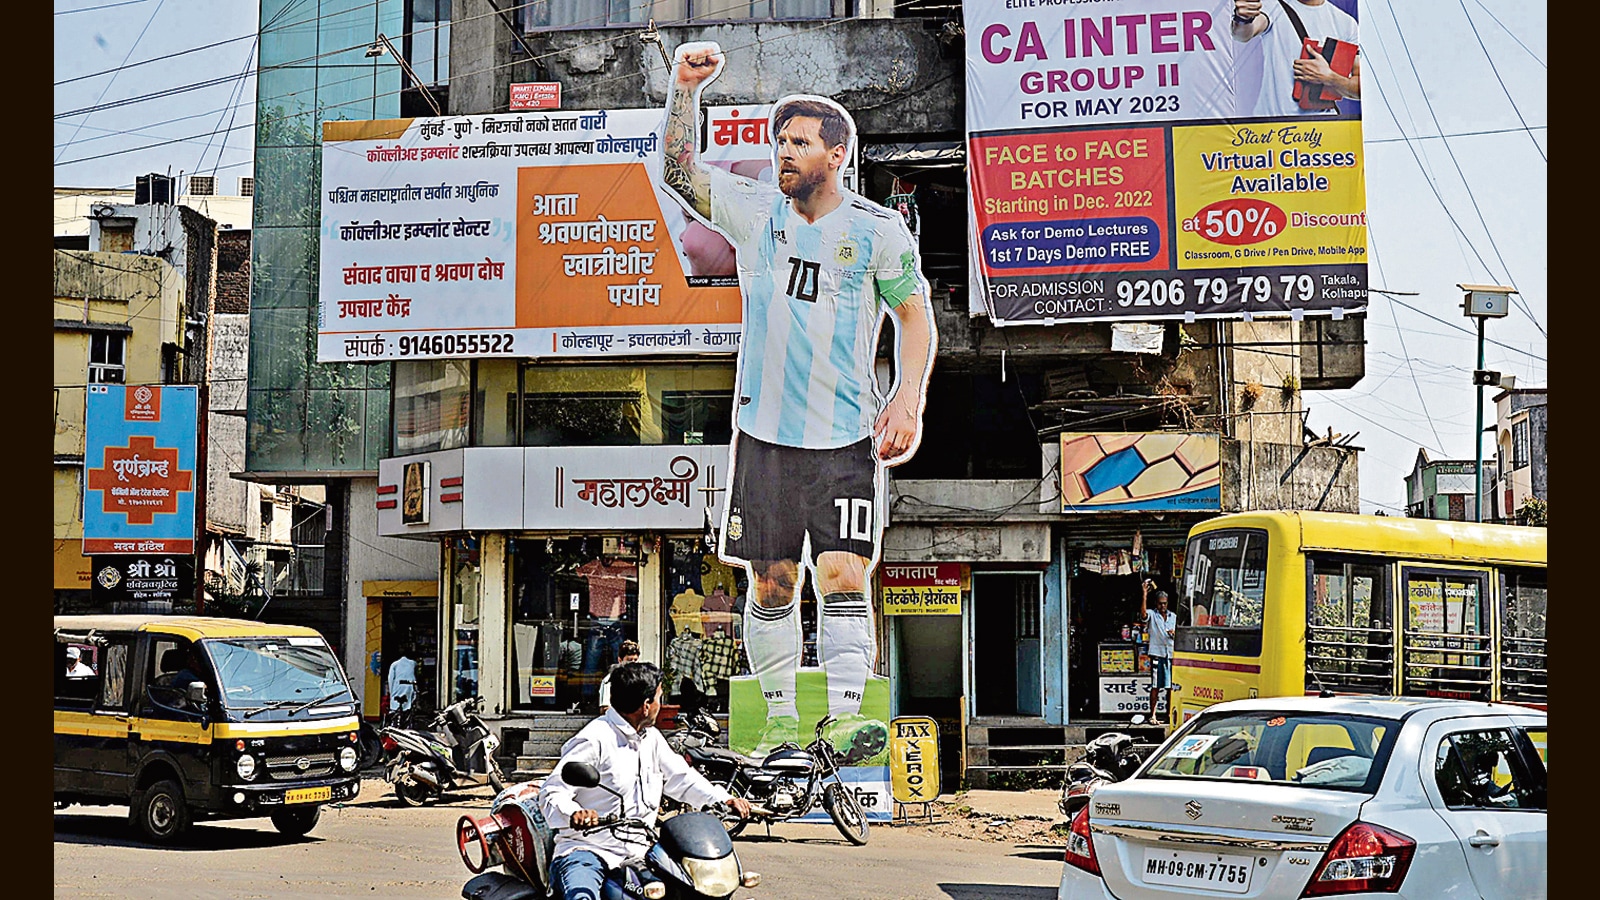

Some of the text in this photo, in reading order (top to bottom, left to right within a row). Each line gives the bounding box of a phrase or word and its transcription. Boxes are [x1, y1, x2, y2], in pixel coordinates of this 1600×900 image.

[980, 11, 1216, 65] CA INTER
[1019, 63, 1180, 95] GROUP II
[1021, 95, 1181, 120] FOR MAY 2023
[421, 120, 445, 141] मुंबई
[453, 119, 473, 139] पुणे
[481, 116, 523, 134] मिरजची
[526, 116, 550, 132] नको
[552, 118, 578, 132] सतत
[579, 110, 607, 131] वारी
[712, 109, 771, 147] संवा
[1231, 126, 1323, 148] Start Early
[554, 141, 594, 156] आपल्या
[596, 132, 658, 158] कोल्हापूरी
[985, 139, 1149, 166] FACE to FACE
[1201, 149, 1356, 171] Virtual Classes
[1011, 166, 1125, 190] BATCHES
[1231, 172, 1329, 194] Available
[328, 186, 359, 204] पश्चिम
[424, 182, 452, 200] सर्वात
[455, 181, 500, 203] आधुनिक
[533, 193, 579, 216] आता
[984, 190, 1153, 216] Starting in Dec. 2022
[452, 216, 491, 237] सेन्टर
[538, 214, 657, 244] श्रवणदोषावर
[991, 224, 1148, 241] Ask for Demo Lectures
[1182, 206, 1366, 238] at 50% Discount
[990, 241, 1150, 263] 1st 7 Days Demo FREE
[1184, 250, 1233, 260] Classroom,
[1244, 248, 1266, 257] Drive
[1272, 247, 1290, 256] Pen
[1292, 246, 1316, 256] Drive,
[1318, 246, 1346, 254] Mobile
[1347, 246, 1366, 256] App
[342, 256, 505, 286] संवाद वाचा व श्रवण दोष
[785, 256, 821, 303] 10
[606, 277, 662, 307] पर्याय
[989, 274, 1360, 307] FOR ADMISSION 9206 79 79 79 Takala,
[1322, 287, 1368, 299] Kolhapu
[337, 299, 384, 319] उपचार
[385, 293, 412, 318] केंद्र
[1034, 298, 1104, 314] CONTACT
[344, 334, 385, 357] संपर्क
[399, 333, 514, 356] 9146055522
[561, 331, 613, 351] कोल्हापूर
[628, 329, 692, 348] इचलकरंजी
[834, 498, 872, 542] 10
[885, 566, 938, 579] जगताप
[1195, 637, 1228, 651] EICHER
[1104, 680, 1137, 695] साई
[1193, 686, 1224, 699] SCHOOL BUS
[895, 722, 931, 738] FAX
[906, 739, 924, 797] XEROX
[624, 881, 643, 894] Hero
